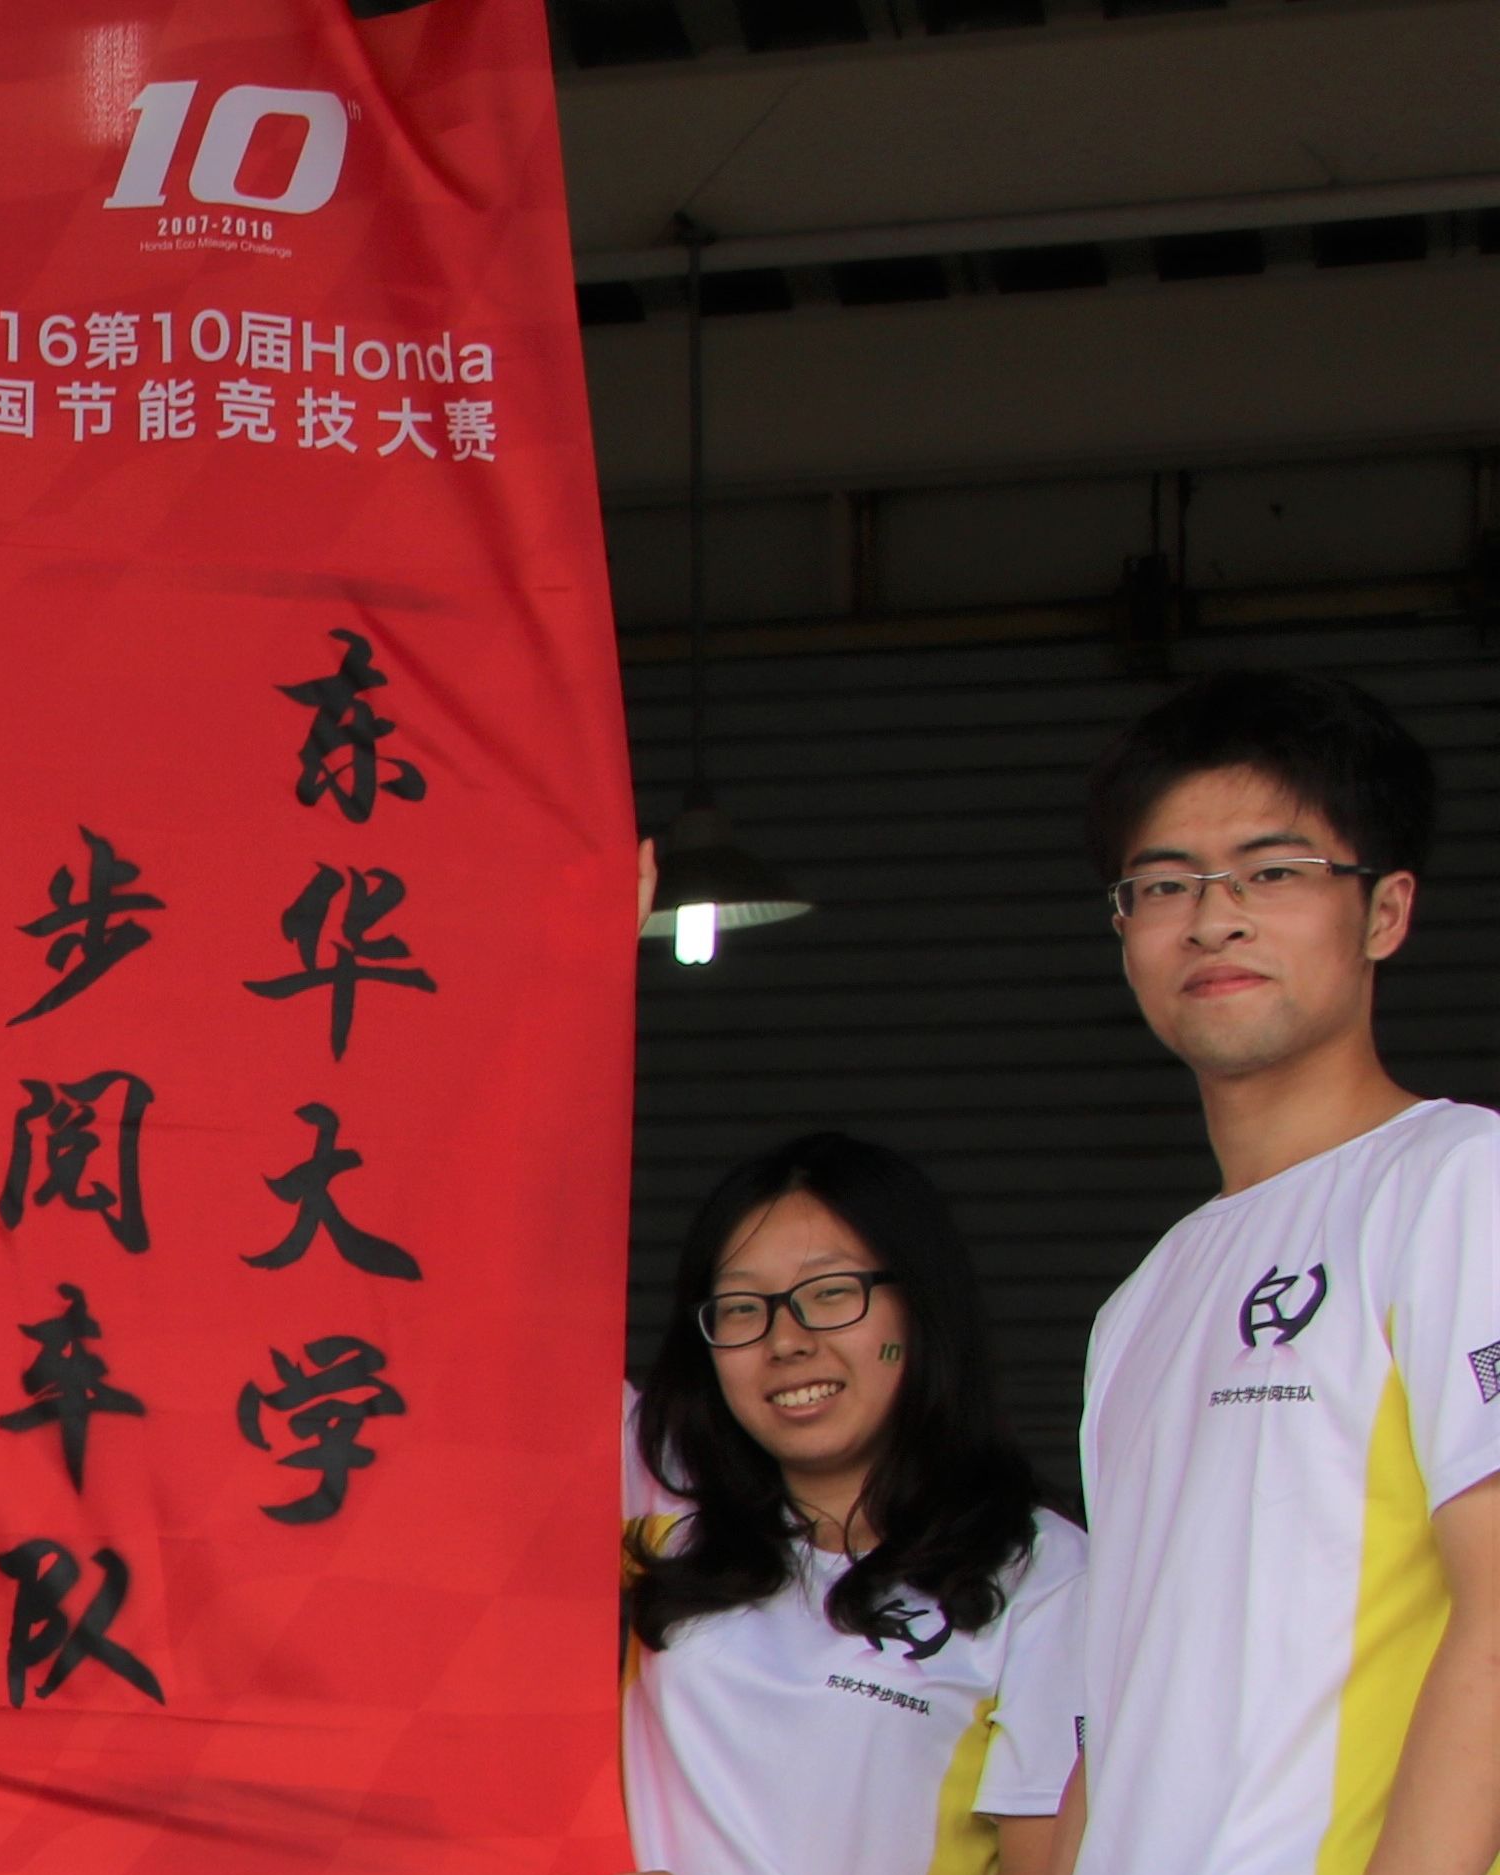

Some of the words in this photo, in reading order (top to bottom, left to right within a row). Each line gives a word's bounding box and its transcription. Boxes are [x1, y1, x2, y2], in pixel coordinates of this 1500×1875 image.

[157, 214, 274, 241] 2007-2016
[139, 239, 174, 252] Honda
[175, 237, 197, 250] Eco
[197, 238, 238, 252] Mileage
[237, 627, 440, 1526] 东华大学
